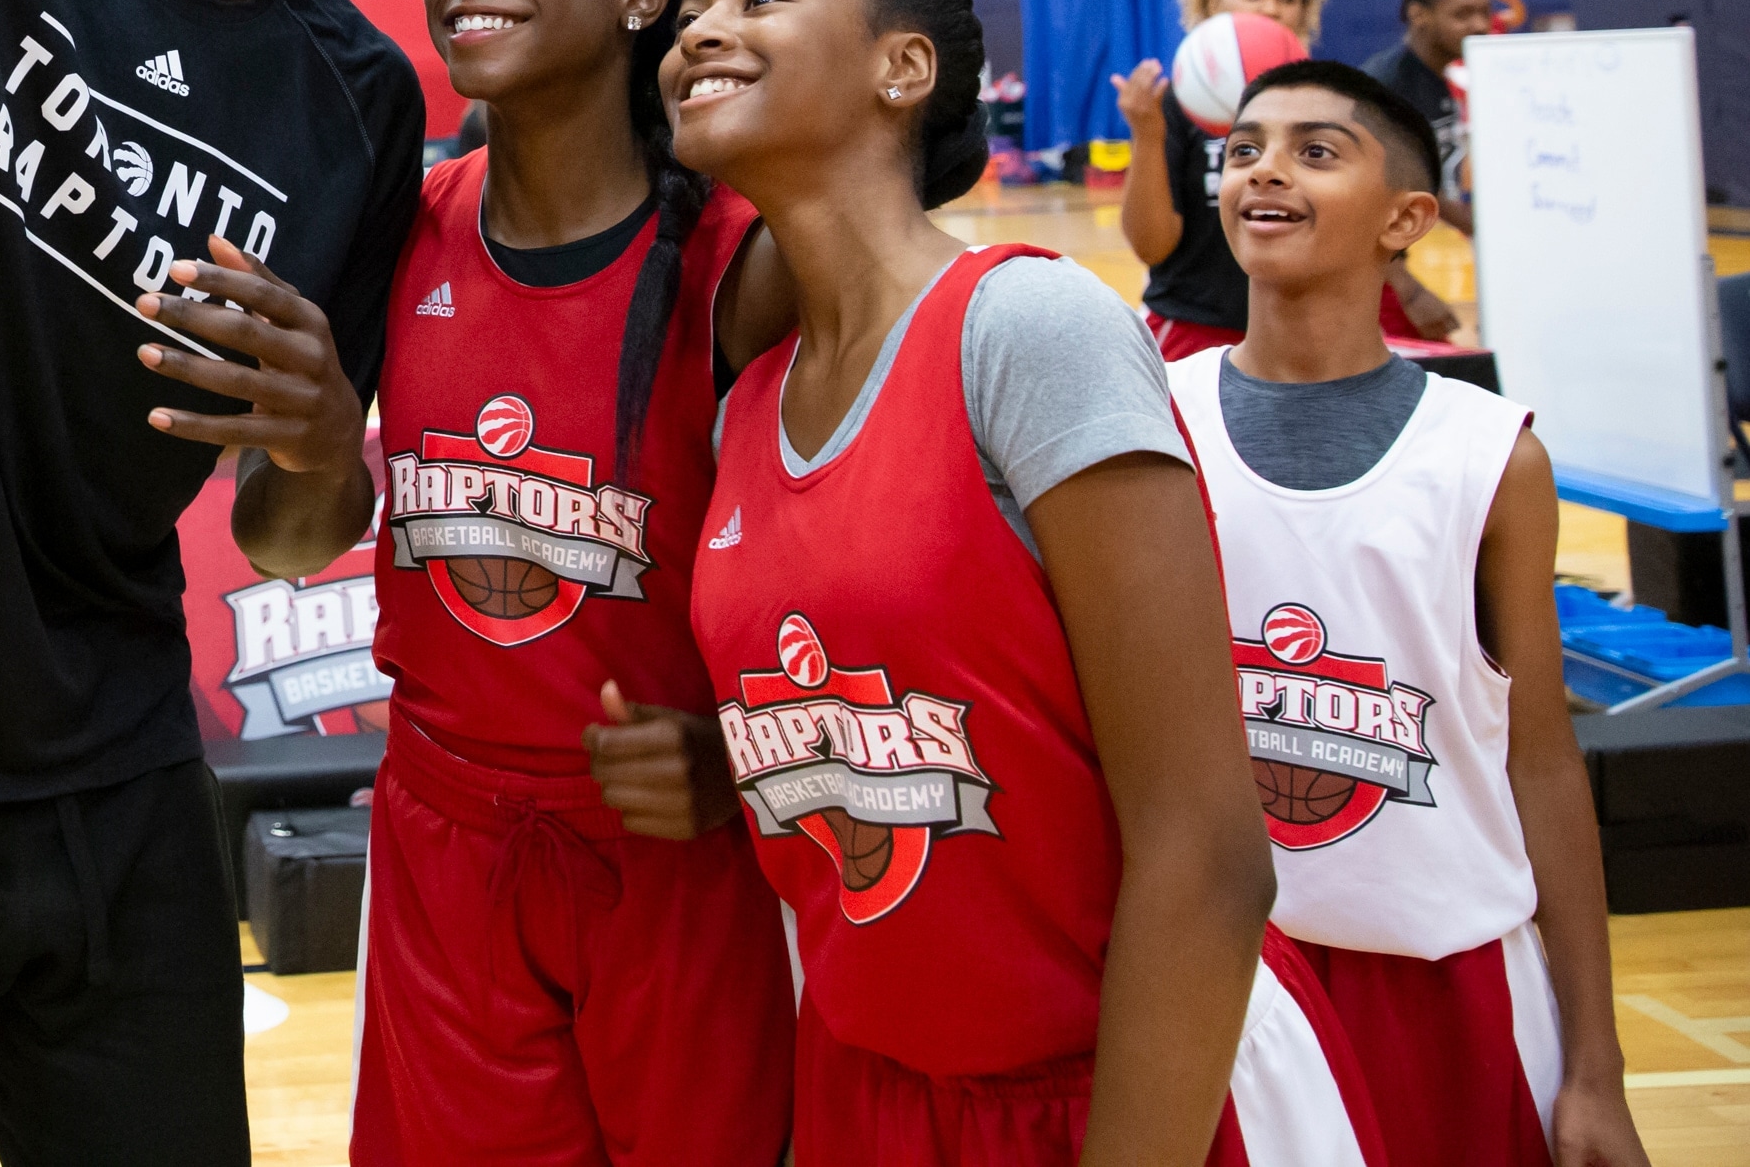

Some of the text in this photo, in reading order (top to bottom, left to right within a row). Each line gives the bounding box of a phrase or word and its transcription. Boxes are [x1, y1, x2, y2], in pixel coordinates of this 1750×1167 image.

[135, 65, 190, 97] adidas
[5, 35, 276, 264] TORONTO
[416, 302, 455, 318] adidas
[390, 455, 648, 561] RAPTORS
[413, 524, 608, 572] BASKETBALL ACADEMY
[283, 660, 391, 706] BASKET
[719, 693, 988, 783] RAPTORS
[1239, 671, 1430, 756] PTORS
[1247, 728, 1404, 779] TBALL ACADEMY
[763, 772, 945, 811] BASKETBA CADEMY
